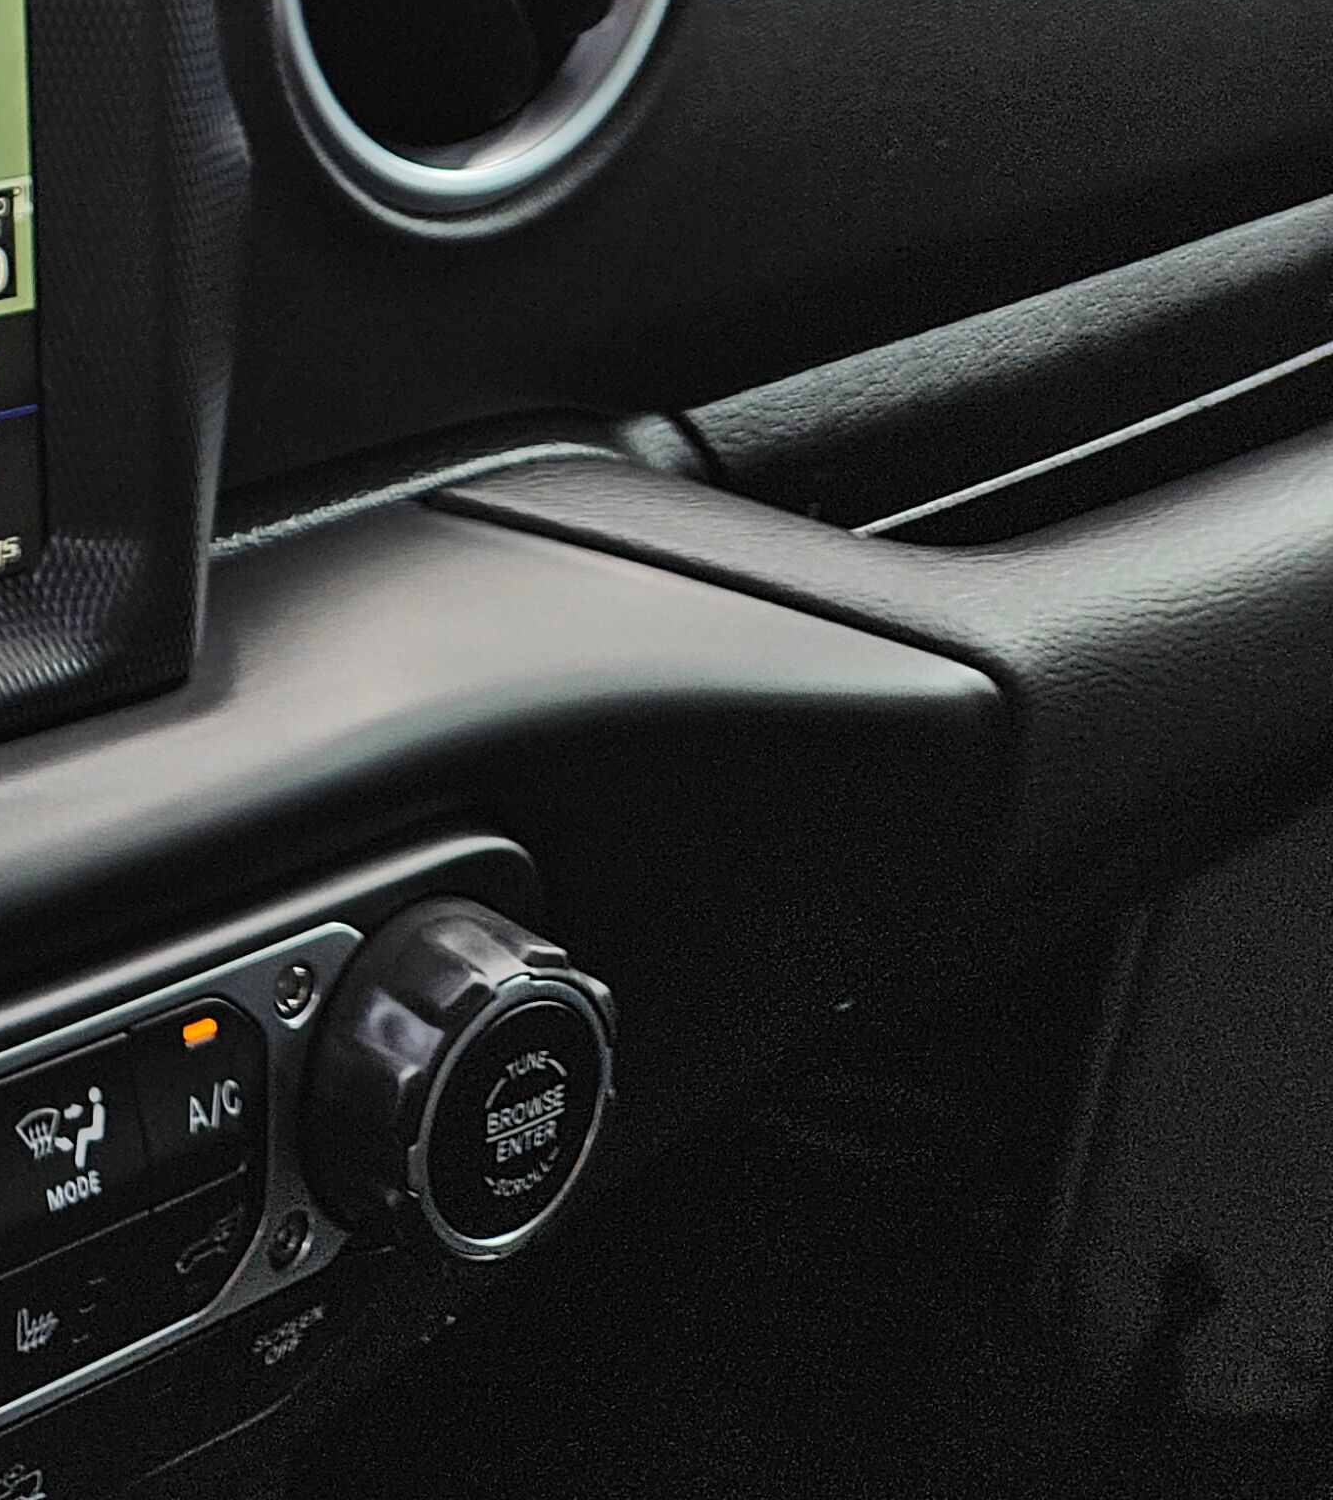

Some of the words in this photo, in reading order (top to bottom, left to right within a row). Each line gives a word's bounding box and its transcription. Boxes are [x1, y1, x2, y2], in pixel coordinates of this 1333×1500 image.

[505, 1049, 550, 1081] TUNE
[188, 1078, 243, 1135] A/C
[486, 1083, 566, 1135] BROWSE
[496, 1119, 558, 1163] ENTER
[46, 1168, 103, 1213] MODE
